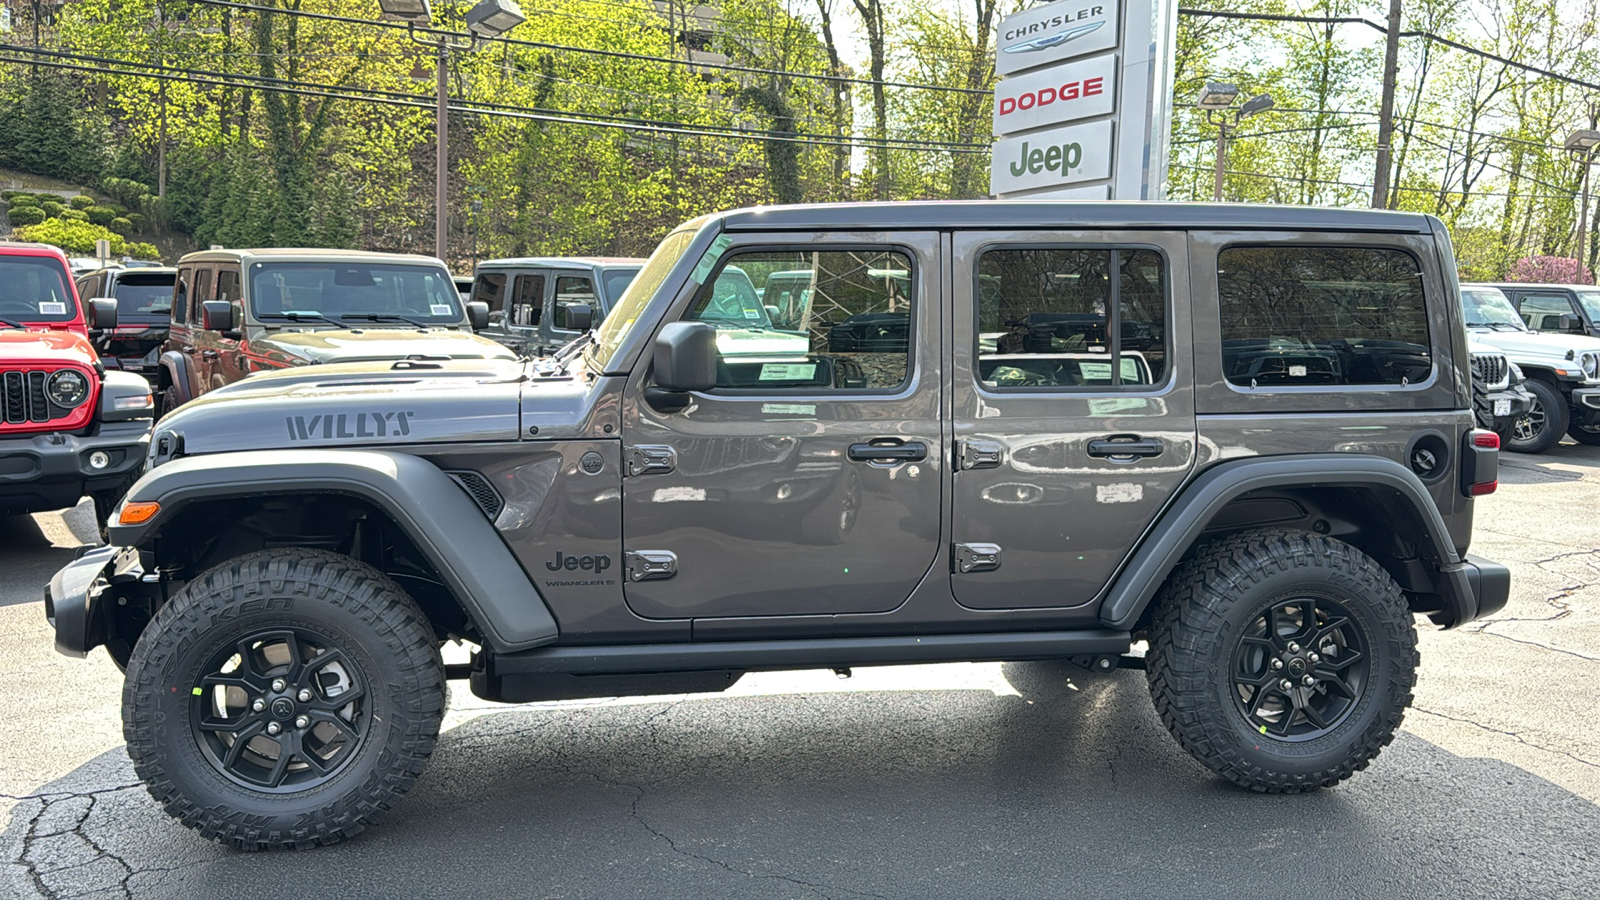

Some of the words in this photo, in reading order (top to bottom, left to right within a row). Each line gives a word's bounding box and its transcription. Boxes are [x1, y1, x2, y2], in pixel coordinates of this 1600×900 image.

[1004, 6, 1104, 41] CHRYSLER
[999, 76, 1104, 116] DODGE
[1009, 141, 1082, 178] Jeep
[285, 411, 414, 441] WILLYS
[545, 549, 611, 574] Jeep
